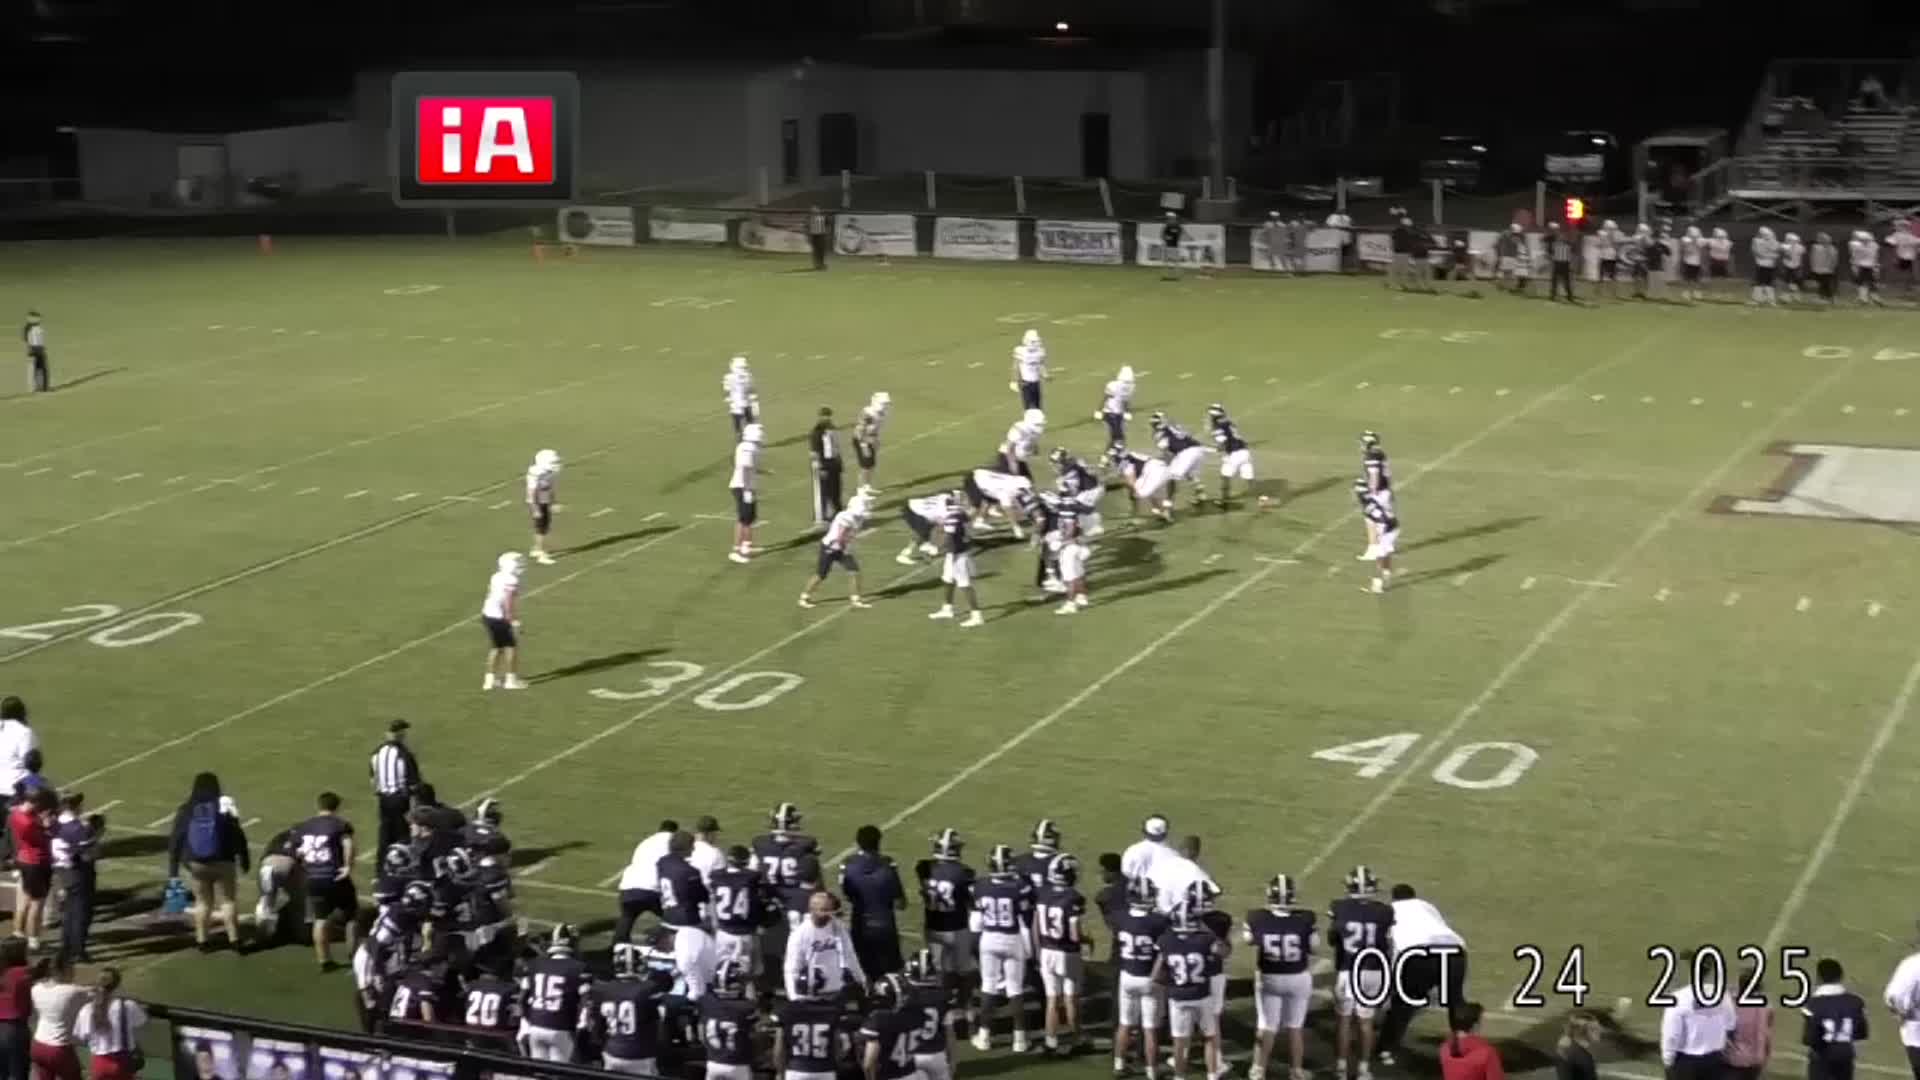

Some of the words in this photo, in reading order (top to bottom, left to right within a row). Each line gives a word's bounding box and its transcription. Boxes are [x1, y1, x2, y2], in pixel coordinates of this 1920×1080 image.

[1566, 197, 1583, 218] 3
[0, 604, 203, 647] 20
[588, 660, 803, 711] 30
[1311, 733, 1538, 788] 40
[715, 886, 749, 920] 24
[1037, 903, 1064, 939] 13
[1343, 921, 1377, 953] 21
[1263, 934, 1301, 961] 56
[1167, 952, 1205, 985] 32
[465, 991, 501, 1026] 20
[531, 973, 566, 1011] 15
[792, 1024, 830, 1058] 35
